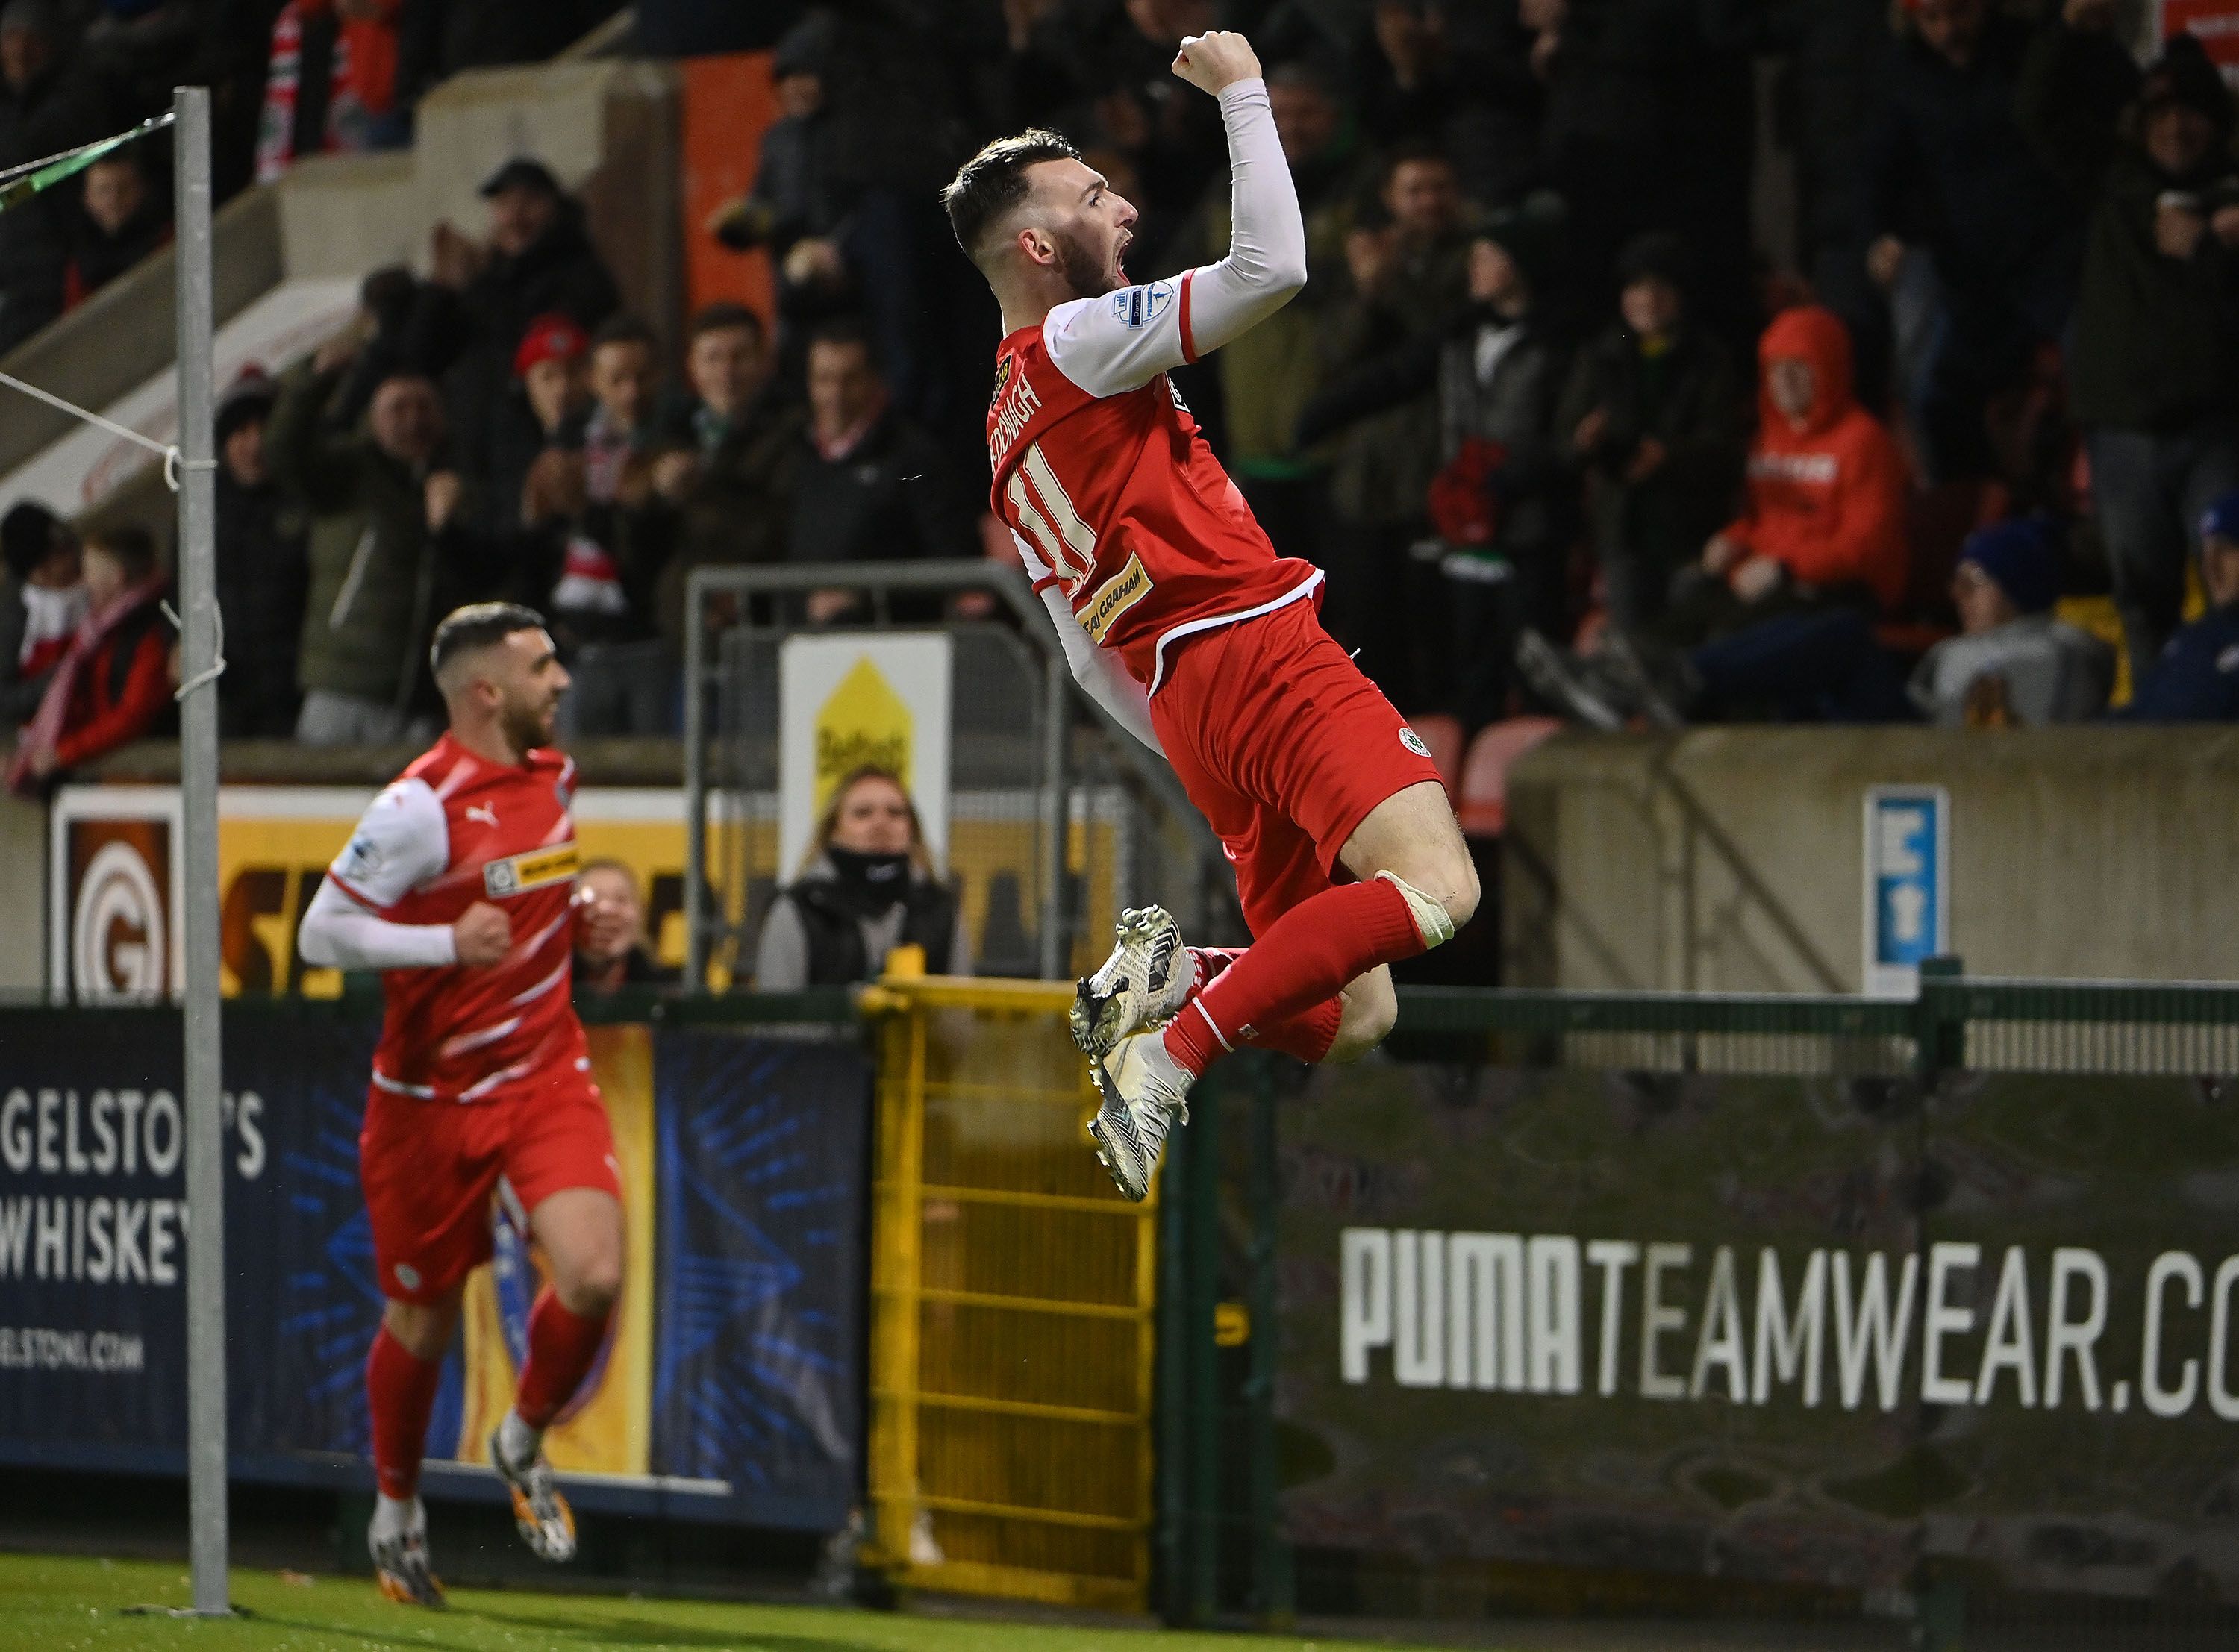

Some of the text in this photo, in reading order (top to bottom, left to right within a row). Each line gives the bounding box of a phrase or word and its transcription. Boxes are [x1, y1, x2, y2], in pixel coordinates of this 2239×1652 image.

[1008, 439, 1097, 601] 11
[1099, 567, 1141, 618] GRAHAM
[1, 1087, 266, 1180] GELSTO'S
